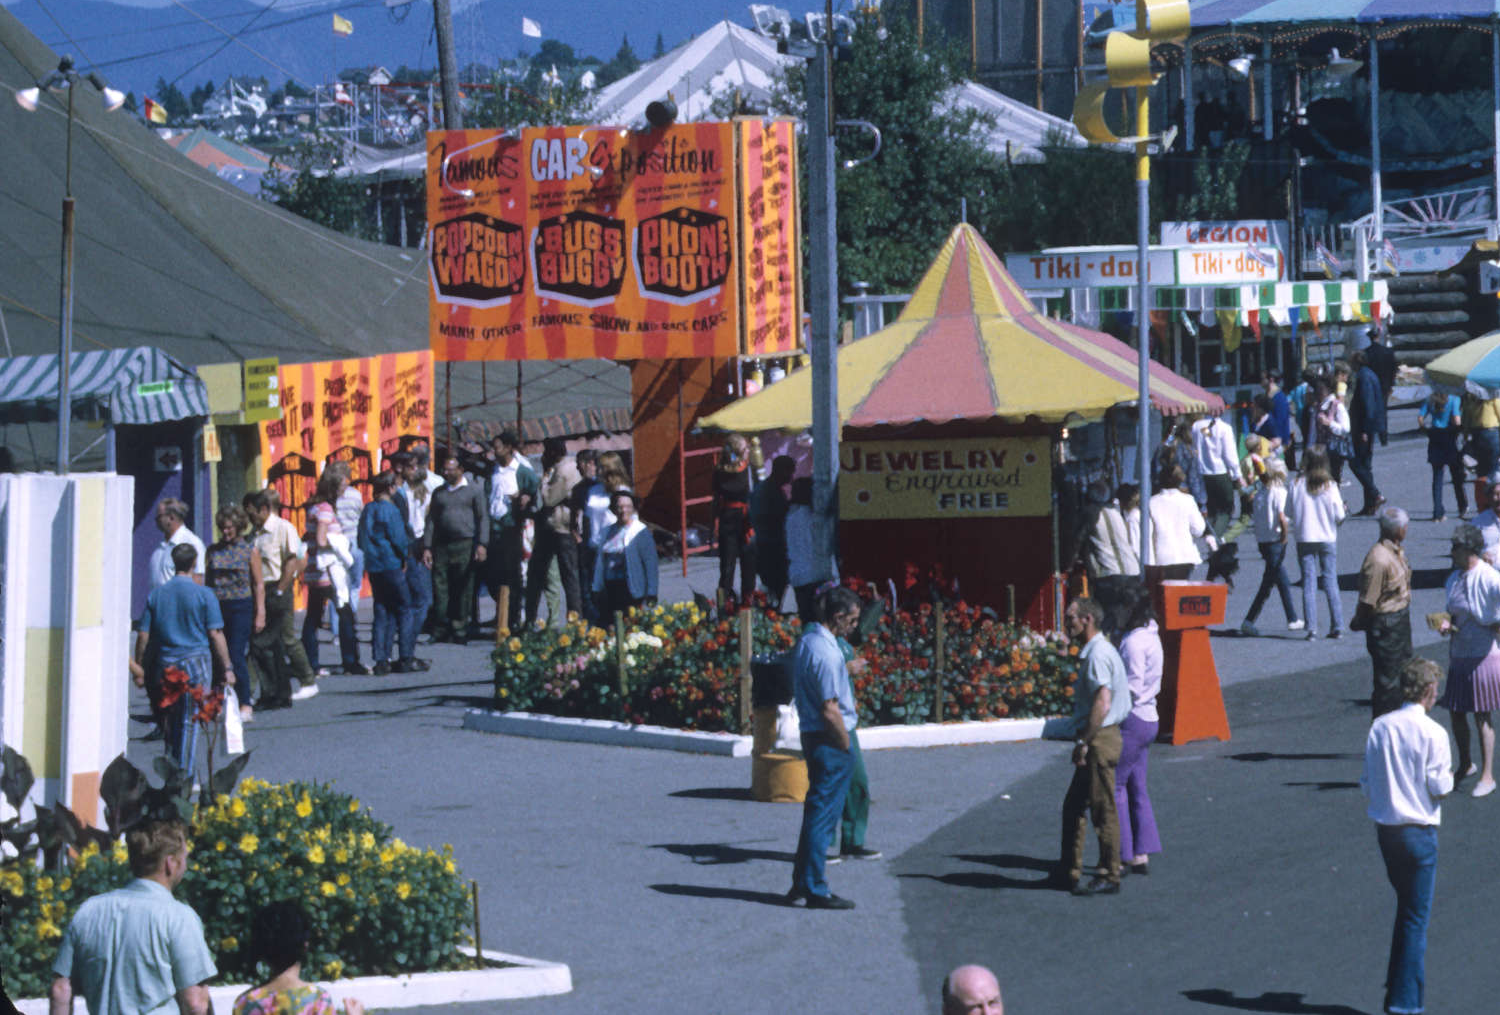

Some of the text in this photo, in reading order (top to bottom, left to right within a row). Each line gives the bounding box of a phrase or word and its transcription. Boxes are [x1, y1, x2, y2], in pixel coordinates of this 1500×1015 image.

[430, 135, 722, 189] Famous CAR Exposition
[435, 220, 523, 258] POPCORN
[543, 219, 622, 259] BUGS
[641, 218, 728, 258] PHONE
[1186, 226, 1268, 244] LEGION
[436, 250, 524, 288] WAGON
[540, 249, 624, 288] BUGGY
[643, 253, 727, 292] BOOTH
[439, 322, 475, 340] MANY
[482, 323, 523, 340] OTHER
[532, 313, 583, 327] FAMOUS
[589, 313, 631, 332] SHOW
[692, 311, 728, 332] CARS
[840, 447, 1008, 472] JEWELRY
[885, 466, 1022, 494] Engraved
[938, 492, 1009, 511] FREE
